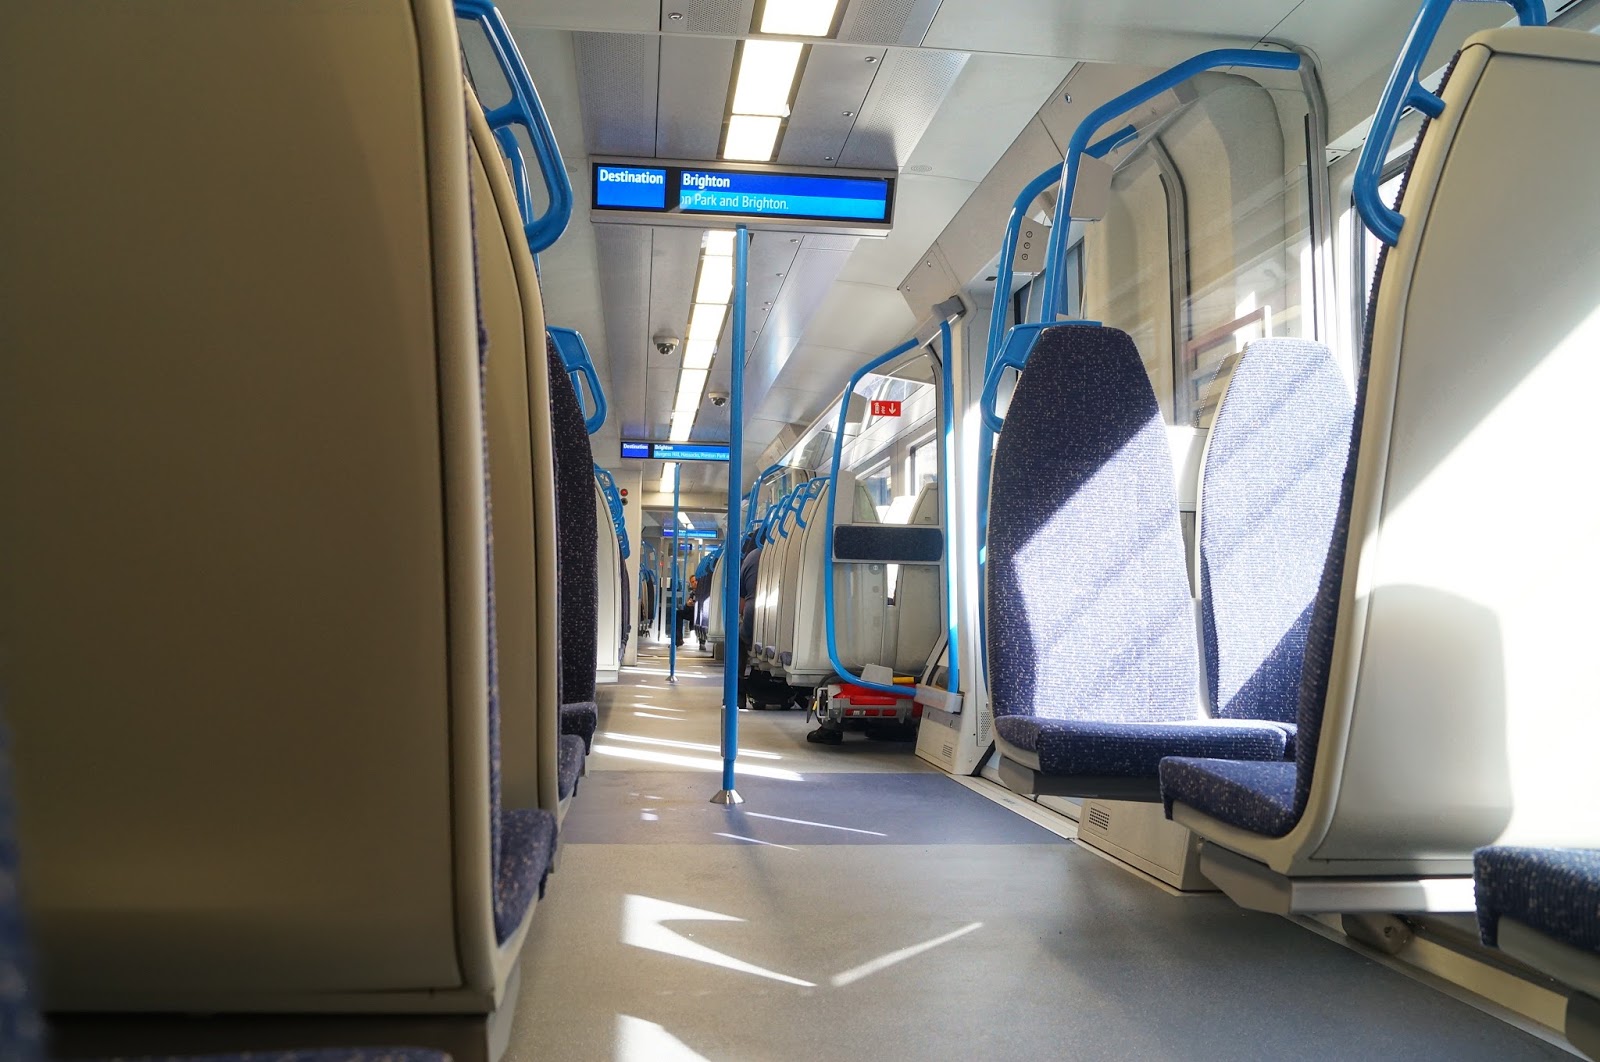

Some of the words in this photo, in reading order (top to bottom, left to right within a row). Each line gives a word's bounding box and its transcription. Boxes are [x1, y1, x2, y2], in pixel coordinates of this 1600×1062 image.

[600, 169, 664, 184] Destination
[683, 173, 730, 189] Brighton
[694, 193, 717, 206] Park
[720, 195, 739, 207] and
[742, 195, 789, 211] Brighton.
